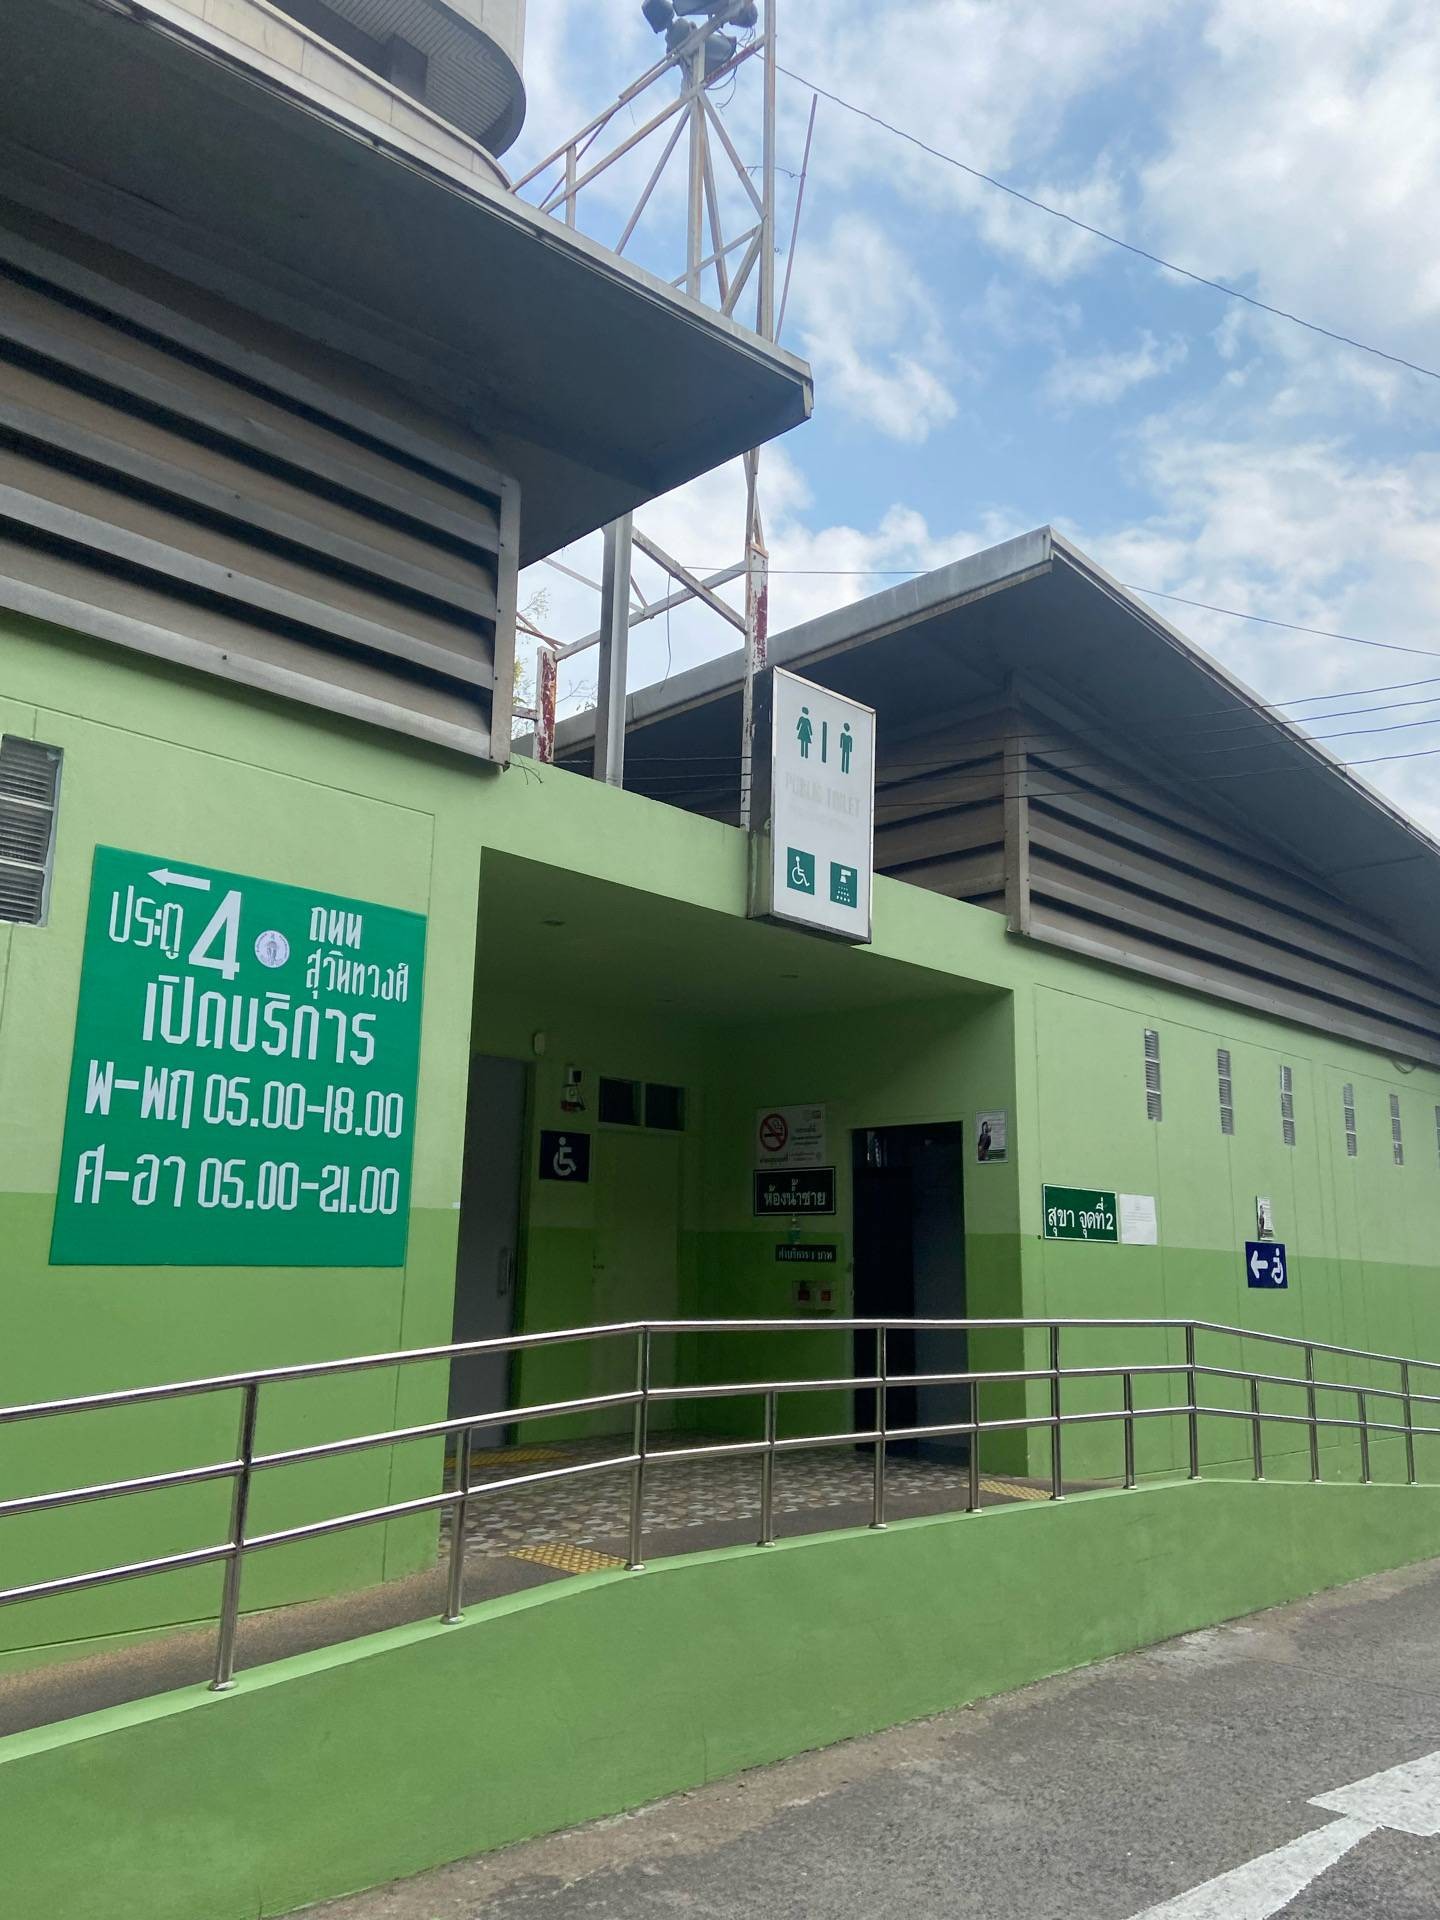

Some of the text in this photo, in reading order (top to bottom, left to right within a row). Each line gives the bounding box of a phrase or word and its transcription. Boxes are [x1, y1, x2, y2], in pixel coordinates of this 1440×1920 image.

[109, 886, 184, 960] ประตู
[189, 891, 241, 980] 4
[306, 949, 409, 1002] สุวินทวงศ์
[142, 975, 377, 1065] เปิดบริการ
[203, 1074, 404, 1138] 05.00-18.00
[197, 1158, 400, 1215] 05.00-21.00
[1047, 1206, 1075, 1237] สุขา
